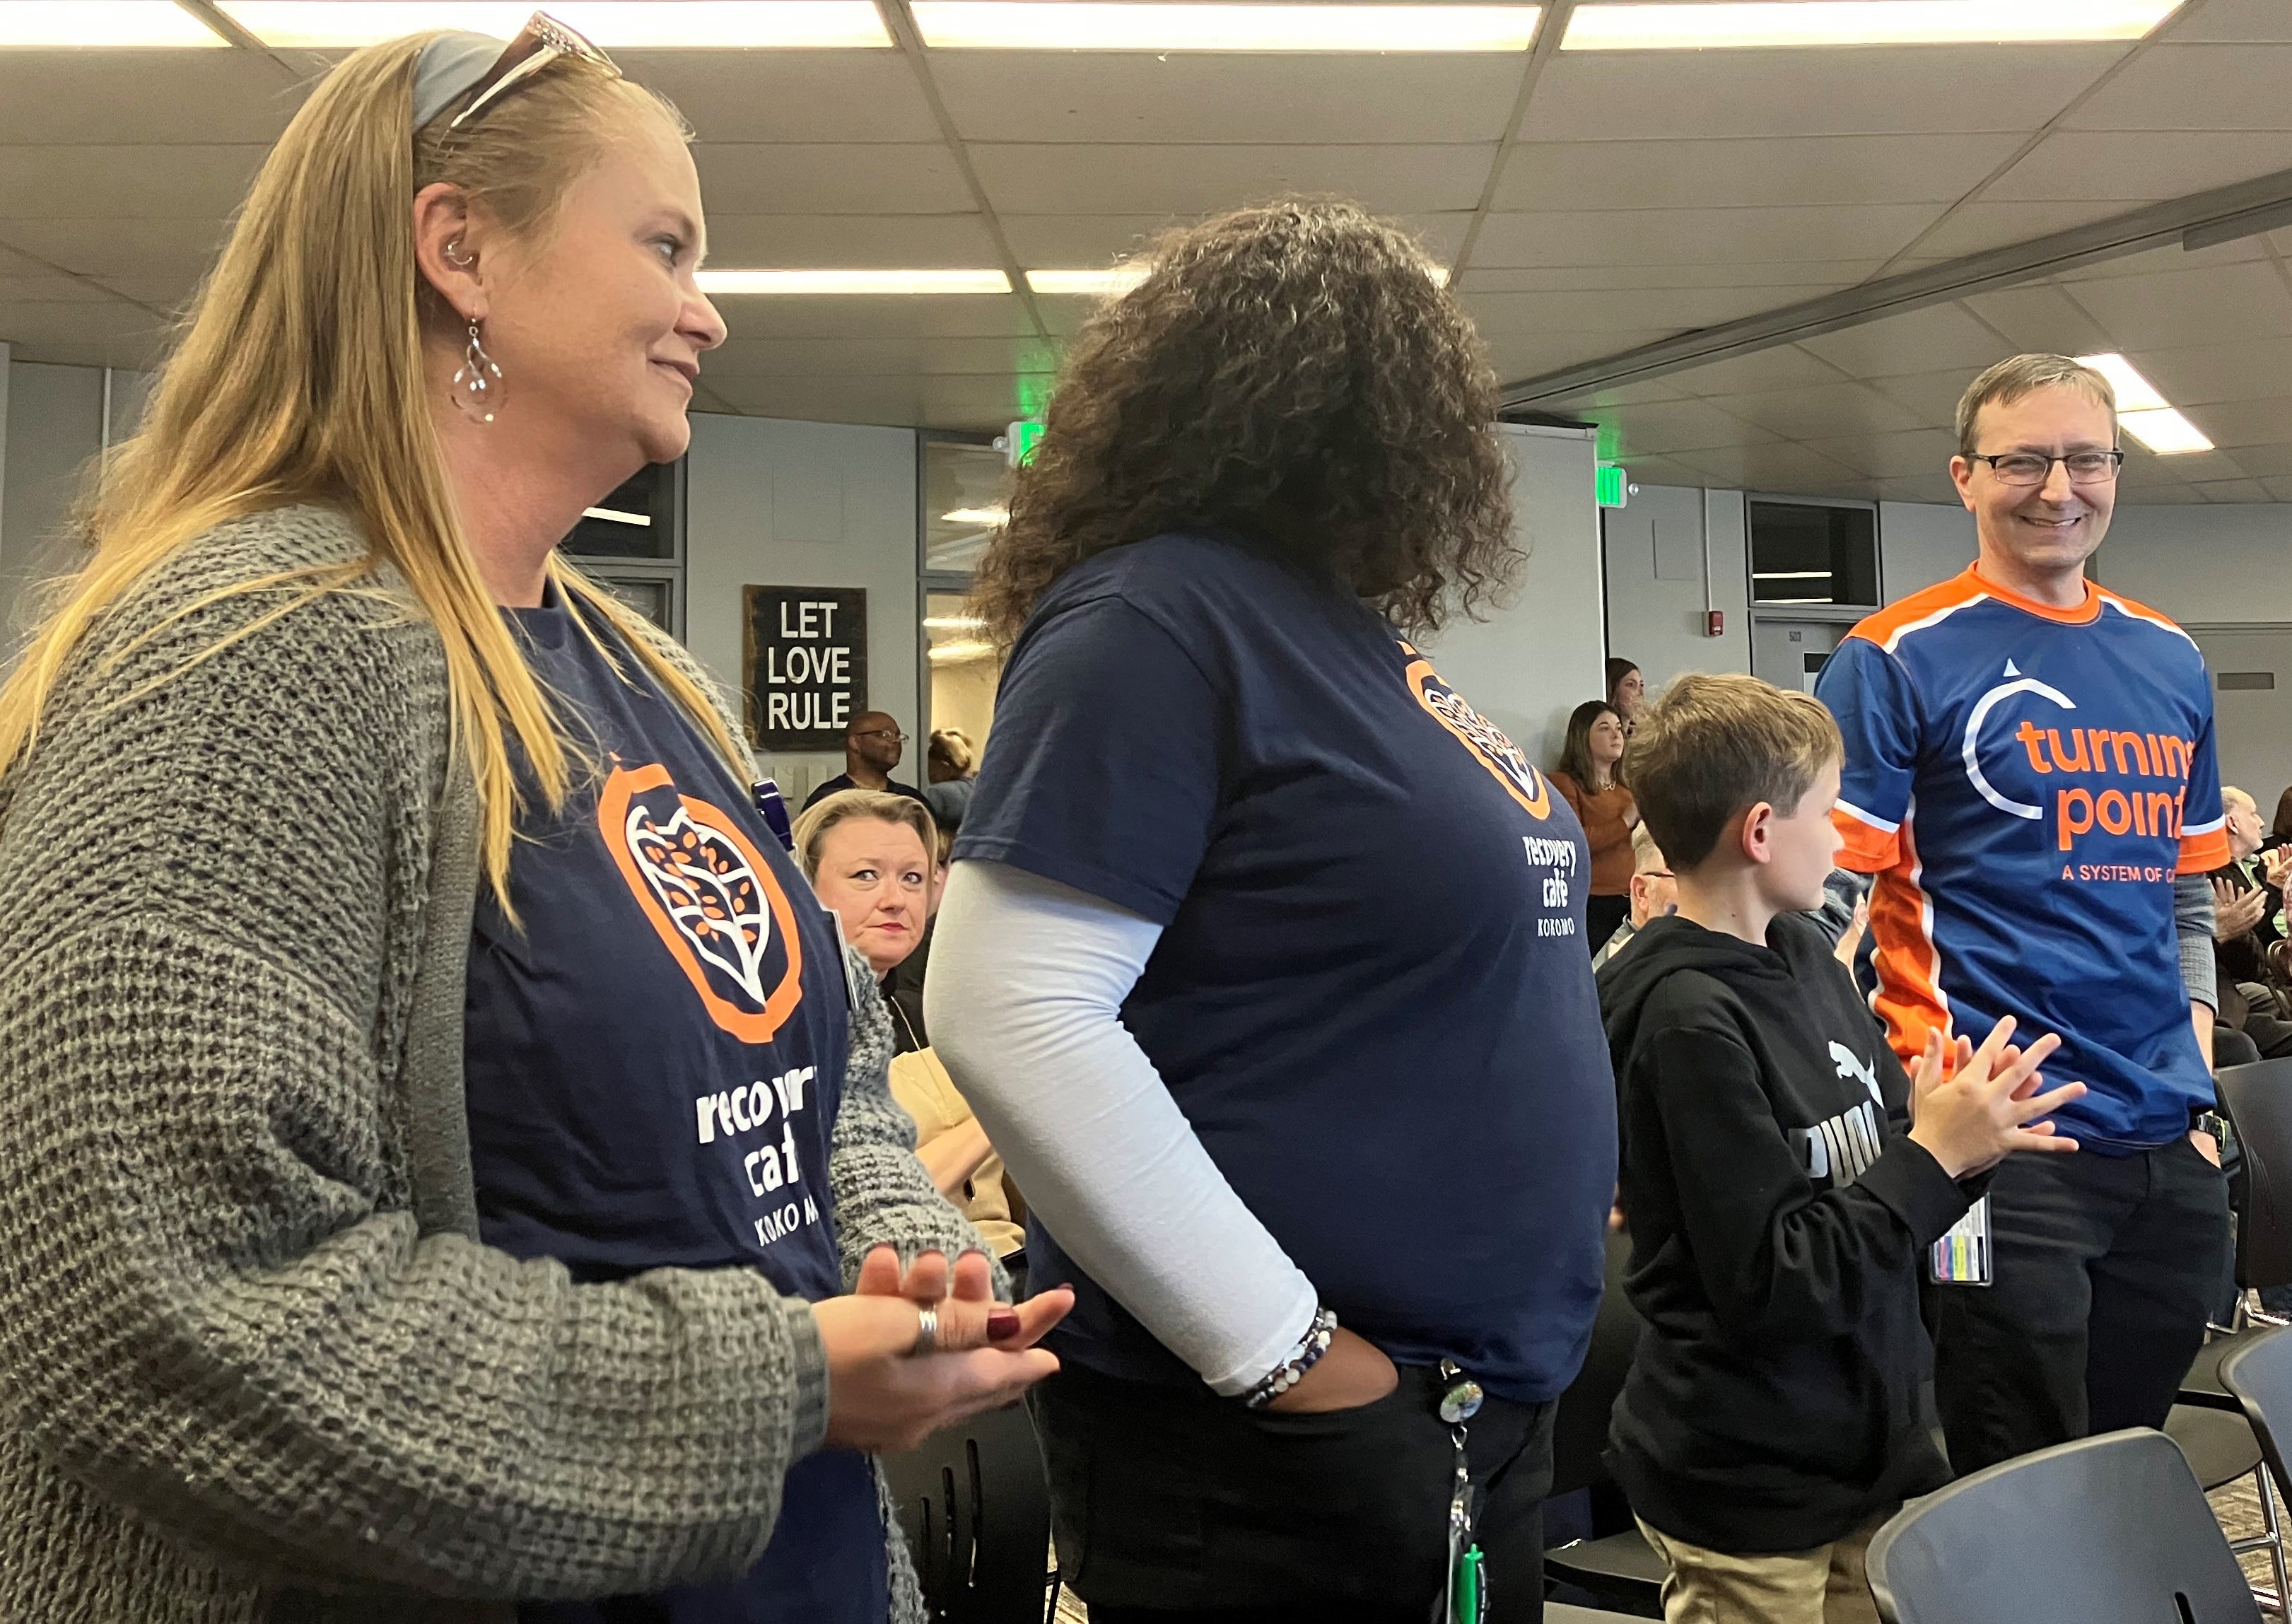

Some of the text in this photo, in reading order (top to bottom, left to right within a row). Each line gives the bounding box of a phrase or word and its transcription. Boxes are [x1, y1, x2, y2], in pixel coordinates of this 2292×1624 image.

[780, 602, 838, 638] LET
[768, 646, 850, 684] LOVE
[768, 692, 850, 730] RULE
[1522, 836, 1577, 877] recovery
[2062, 865, 2074, 881] A
[2079, 865, 2141, 882] SYSTEM
[2144, 867, 2163, 882] OF
[1543, 868, 1569, 908] café
[1538, 917, 1575, 937] KOKOMO
